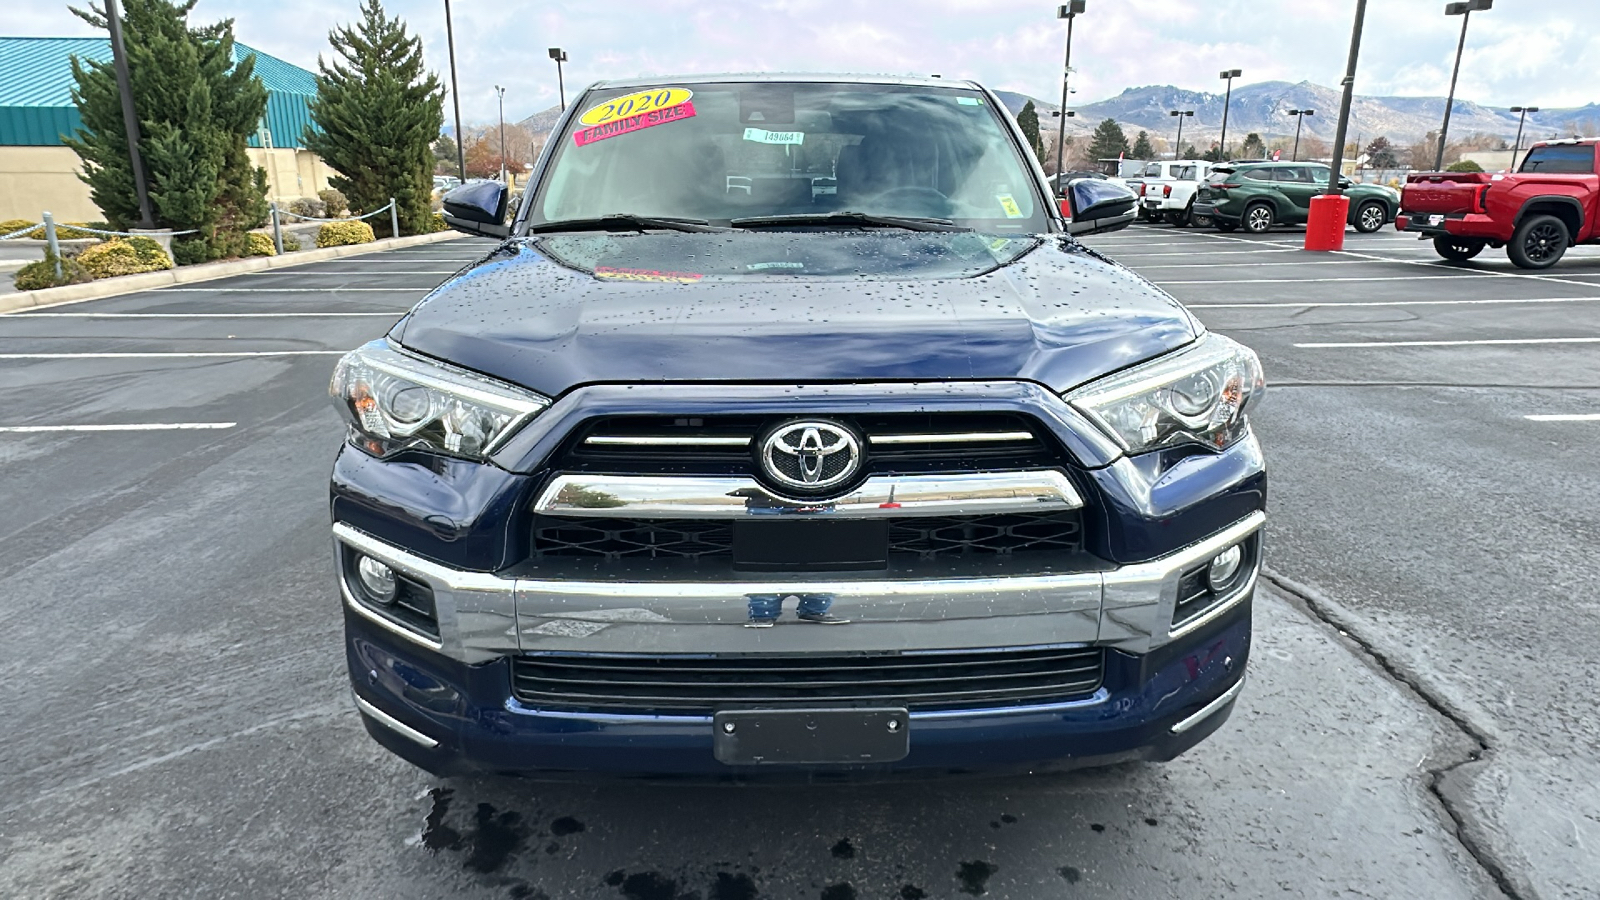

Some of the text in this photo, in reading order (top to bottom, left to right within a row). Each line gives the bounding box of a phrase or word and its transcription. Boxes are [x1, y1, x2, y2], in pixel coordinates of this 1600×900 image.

[584, 104, 687, 142] FAMILY SIZE
[598, 90, 671, 123] 2020
